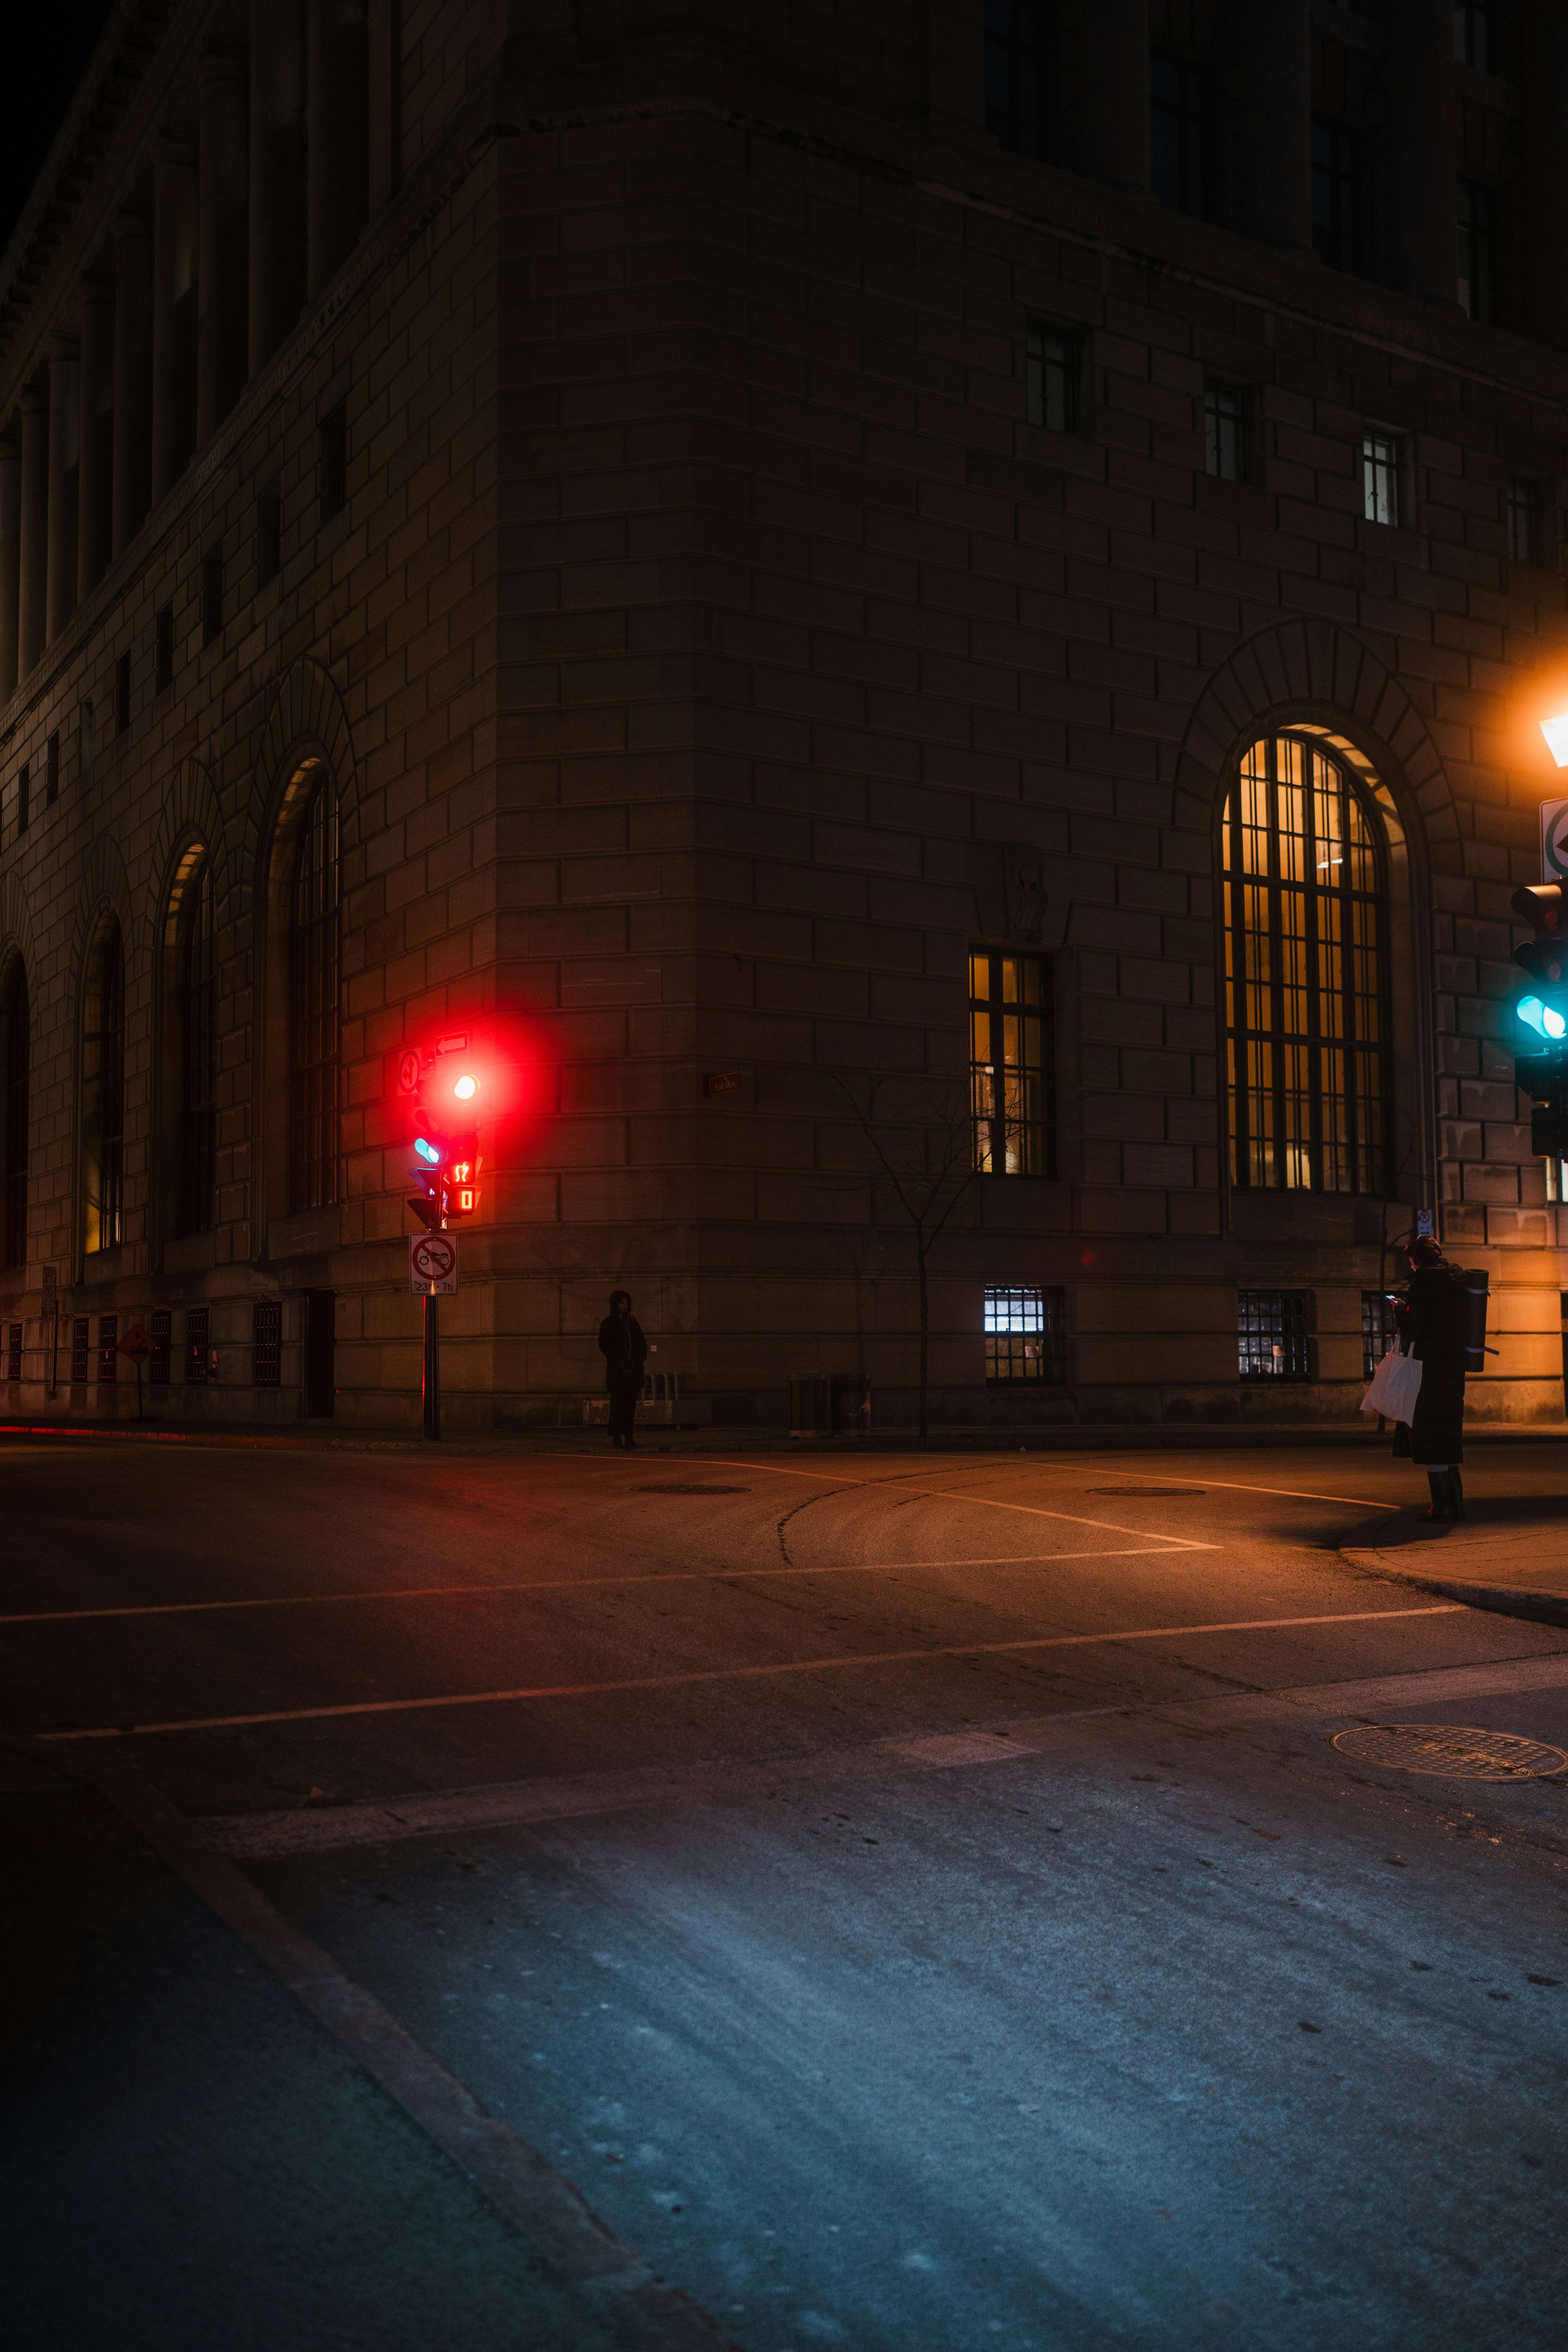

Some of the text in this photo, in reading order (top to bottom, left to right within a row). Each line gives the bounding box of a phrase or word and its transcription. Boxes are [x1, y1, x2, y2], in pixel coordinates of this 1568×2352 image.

[715, 1081, 738, 1091] Saint-Pierre
[462, 1191, 472, 1209] 0
[442, 1283, 452, 1291] 7h
